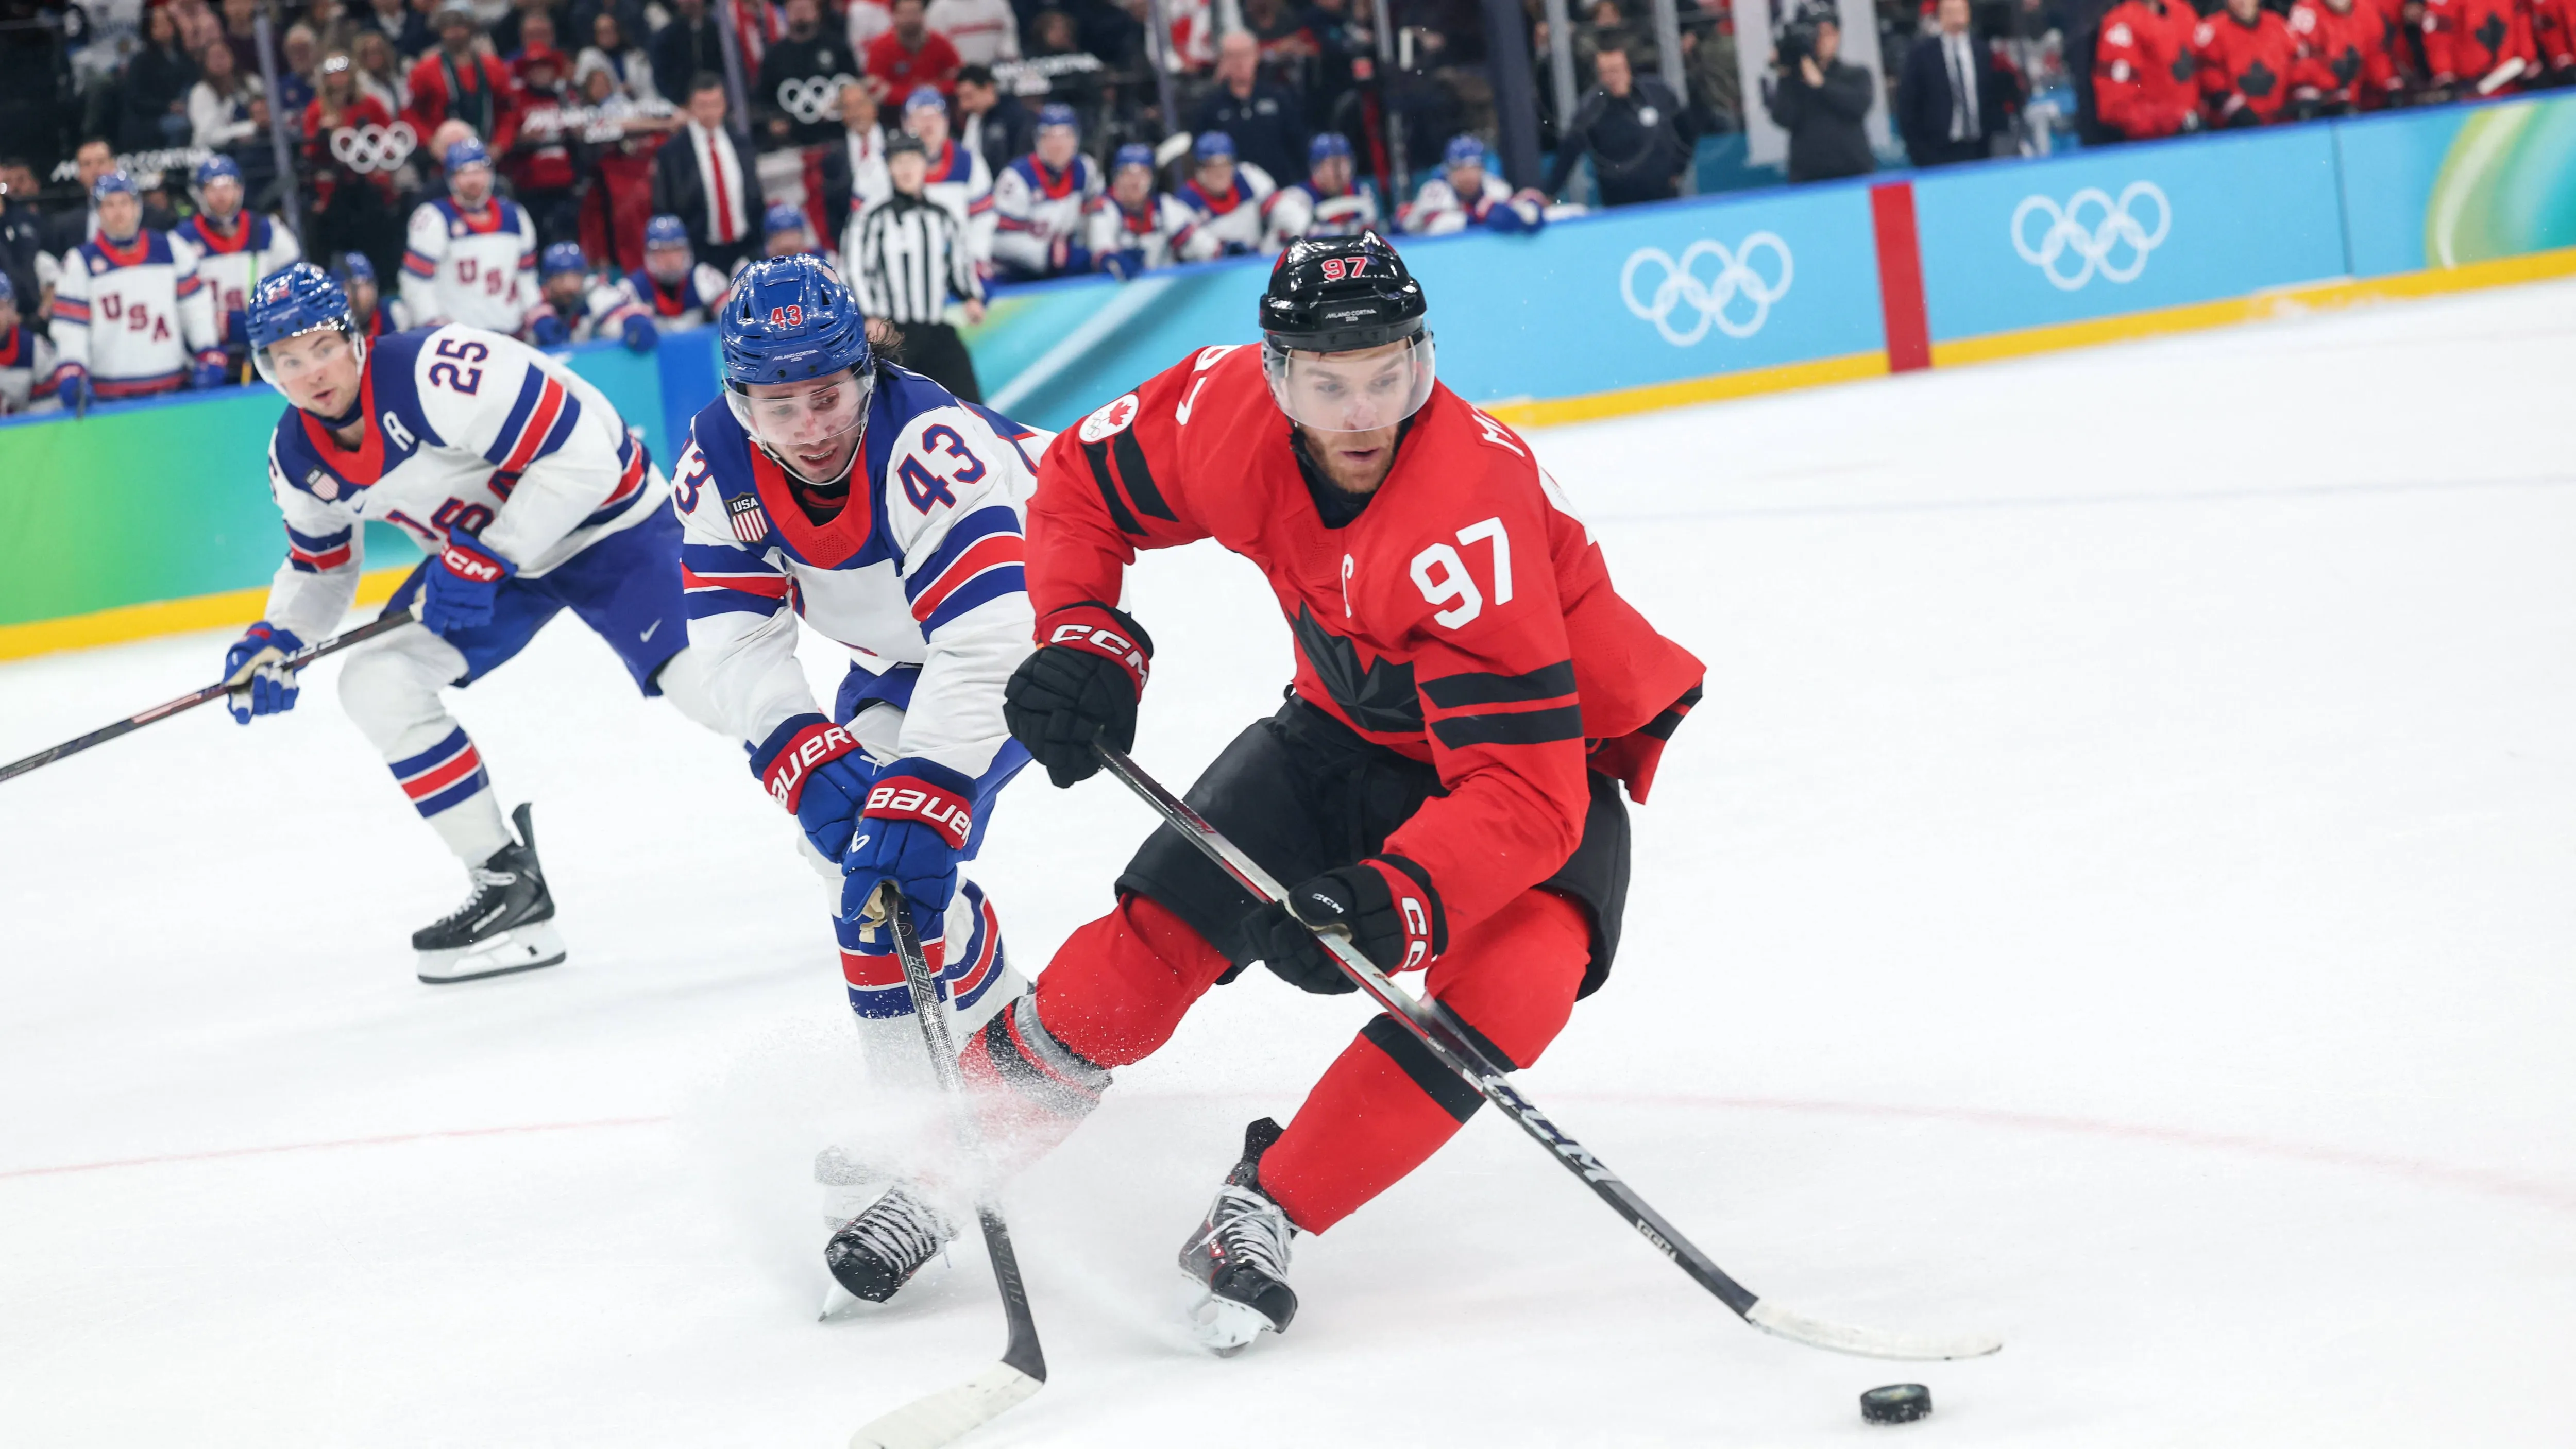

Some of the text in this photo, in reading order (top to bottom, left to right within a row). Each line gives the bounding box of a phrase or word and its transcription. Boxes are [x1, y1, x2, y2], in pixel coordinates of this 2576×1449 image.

[1321, 257, 1368, 281] 97
[100, 292, 169, 342] USA
[771, 304, 803, 329] 43
[428, 338, 490, 397] 25
[383, 411, 416, 451] A
[673, 444, 713, 516] 3
[896, 423, 987, 516] 43
[732, 497, 759, 512] USA
[441, 544, 498, 581] CM
[1410, 517, 1513, 629] 97
[1050, 624, 1148, 688] CCM
[1312, 893, 1344, 914] CCM
[1482, 1075, 1621, 1182] CCM
